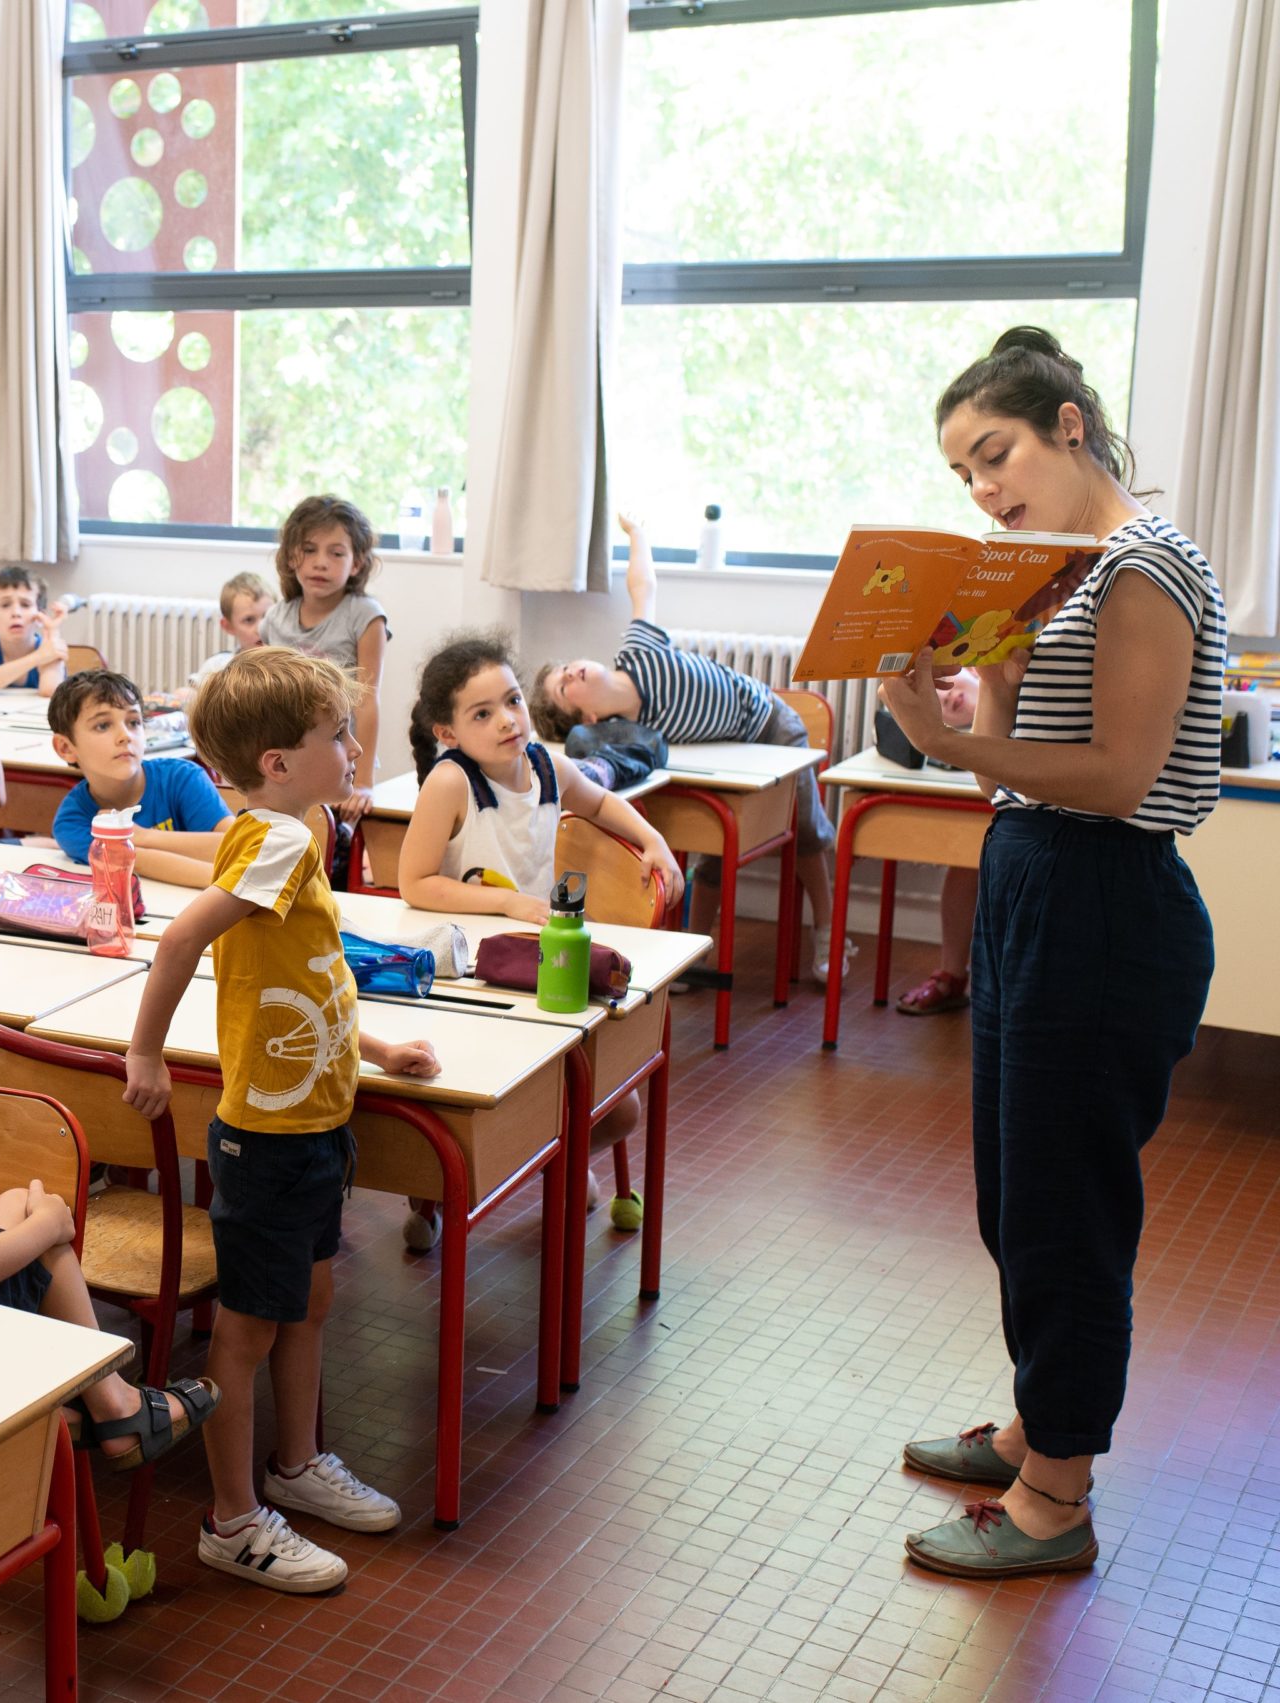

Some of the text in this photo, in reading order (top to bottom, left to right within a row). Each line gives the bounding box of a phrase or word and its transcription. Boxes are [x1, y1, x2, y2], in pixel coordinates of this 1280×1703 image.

[978, 545, 1016, 563] Spot
[1018, 548, 1049, 564] Can
[966, 564, 1016, 582] Count
